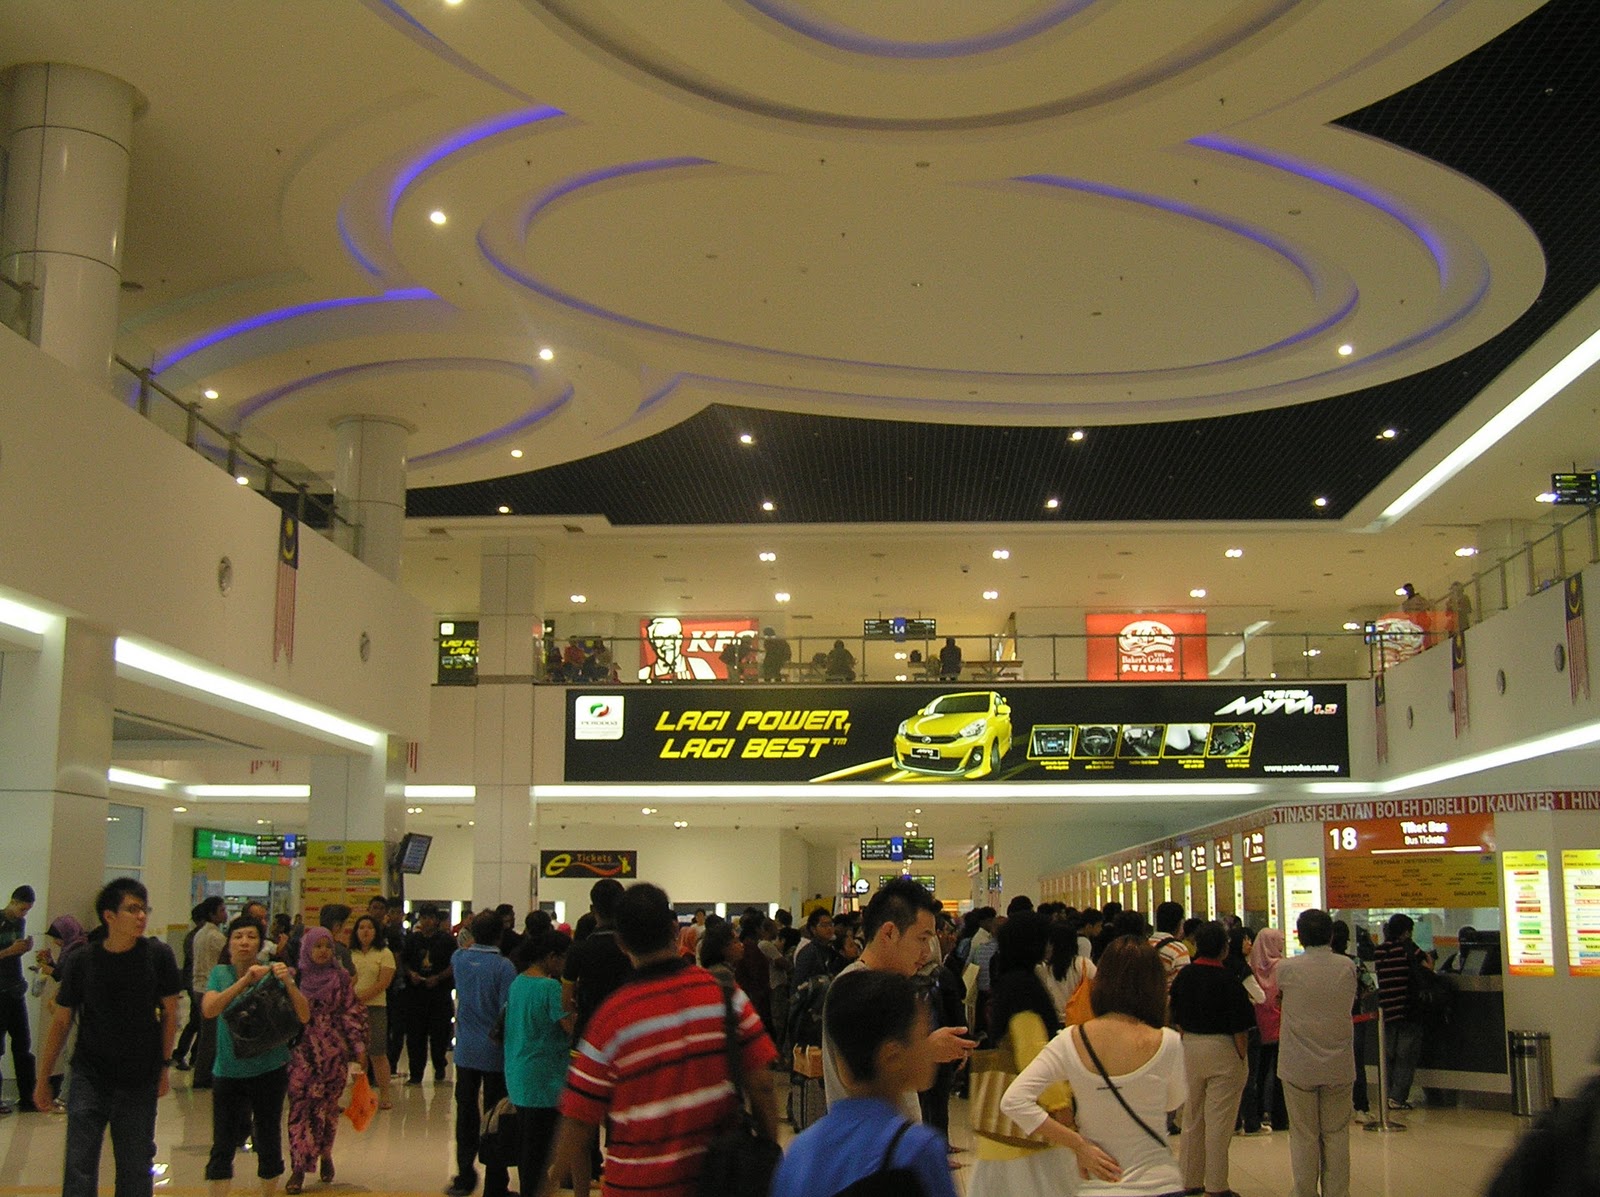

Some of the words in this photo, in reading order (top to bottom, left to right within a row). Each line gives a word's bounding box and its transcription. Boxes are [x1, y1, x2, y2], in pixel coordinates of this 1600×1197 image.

[894, 625, 905, 634] L4
[655, 710, 731, 731] LAGI
[735, 709, 851, 735] POWER,
[659, 738, 736, 759] LAGI
[740, 737, 831, 759] BEST
[1318, 802, 1374, 822] SELATAN
[1375, 799, 1419, 818] BOLEH
[1422, 797, 1465, 816] DIBELI
[1468, 796, 1483, 815] DI
[1486, 791, 1556, 813] KAUNTER
[1558, 792, 1567, 810] 1
[285, 841, 296, 850] L3
[1329, 827, 1358, 850] 18
[892, 844, 903, 854] L3
[576, 853, 612, 864] Tickets
